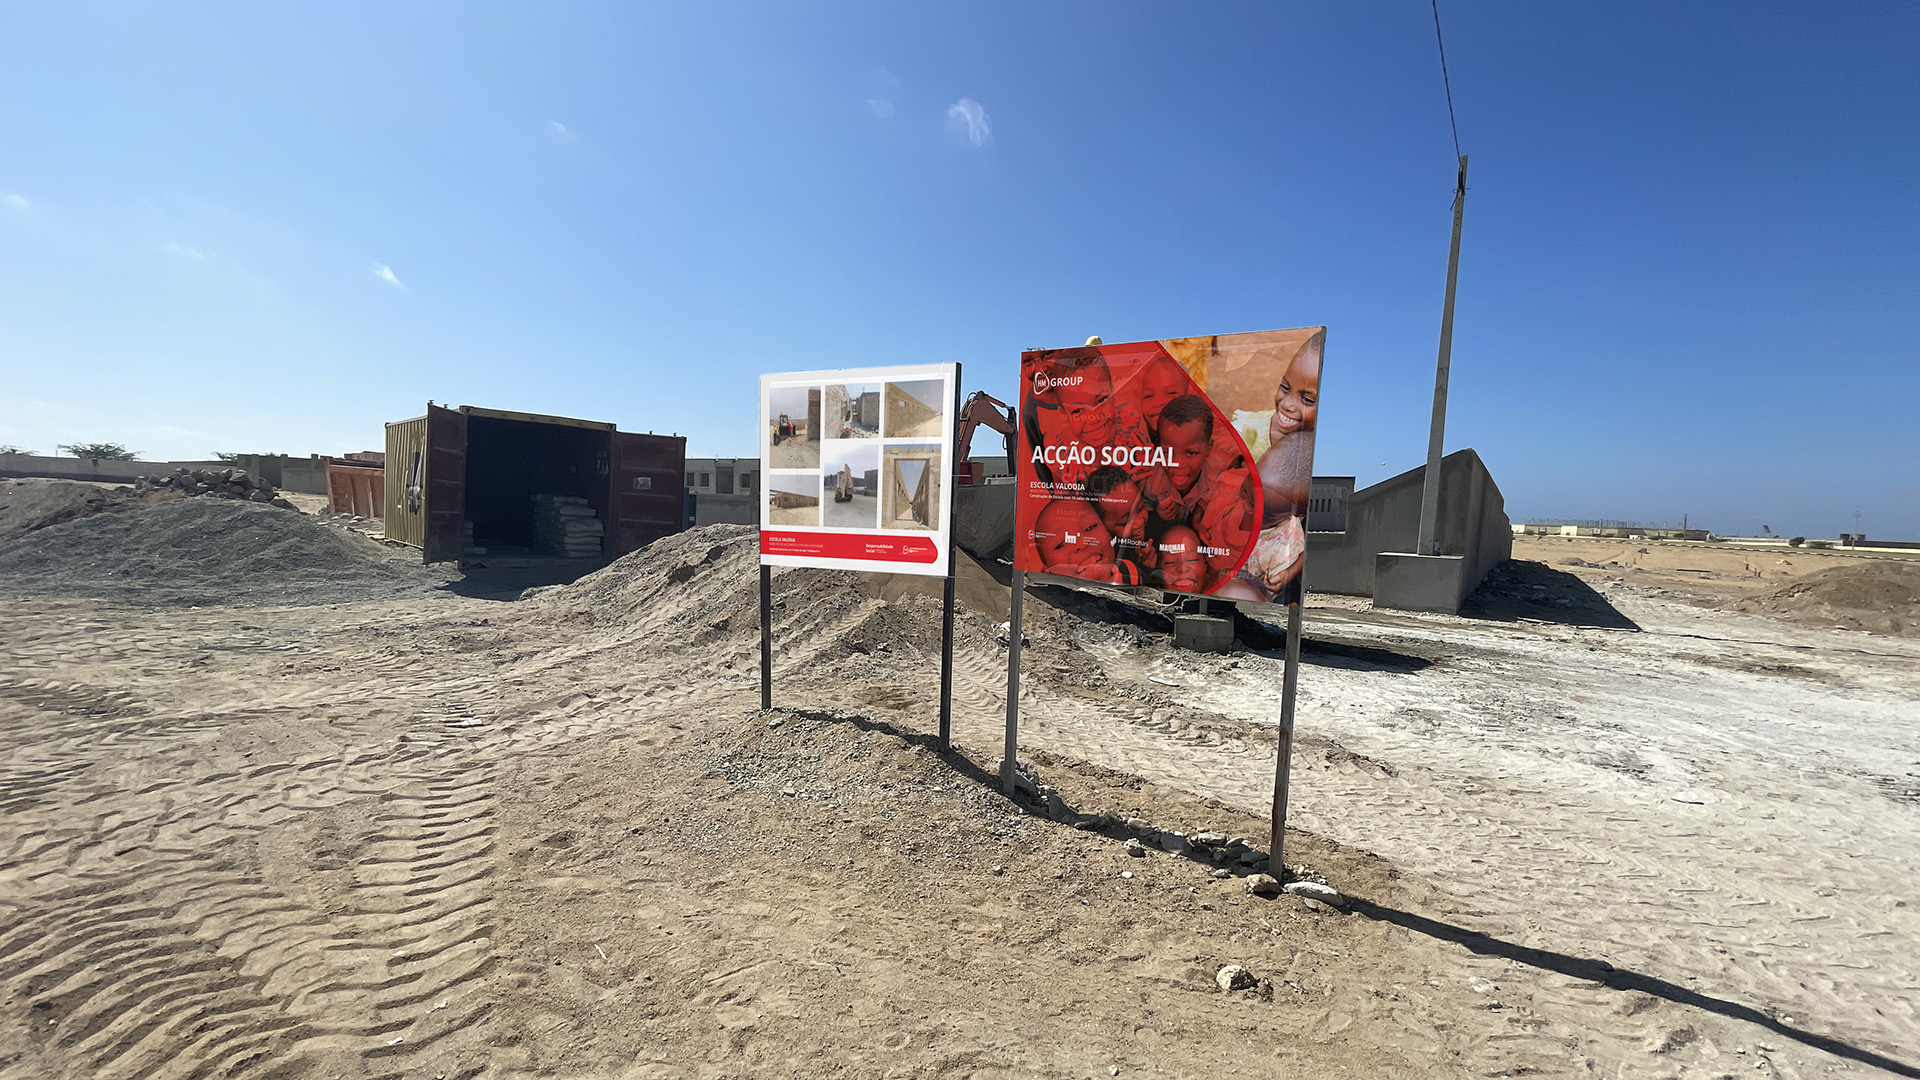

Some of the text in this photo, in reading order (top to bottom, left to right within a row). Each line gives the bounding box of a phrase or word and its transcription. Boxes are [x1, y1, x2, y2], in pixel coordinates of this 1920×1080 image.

[1050, 376, 1083, 387] GROUP
[1031, 441, 1180, 470] ACÇÃO SOCIAL
[1030, 481, 1085, 491] ESCOLA VALODIA
